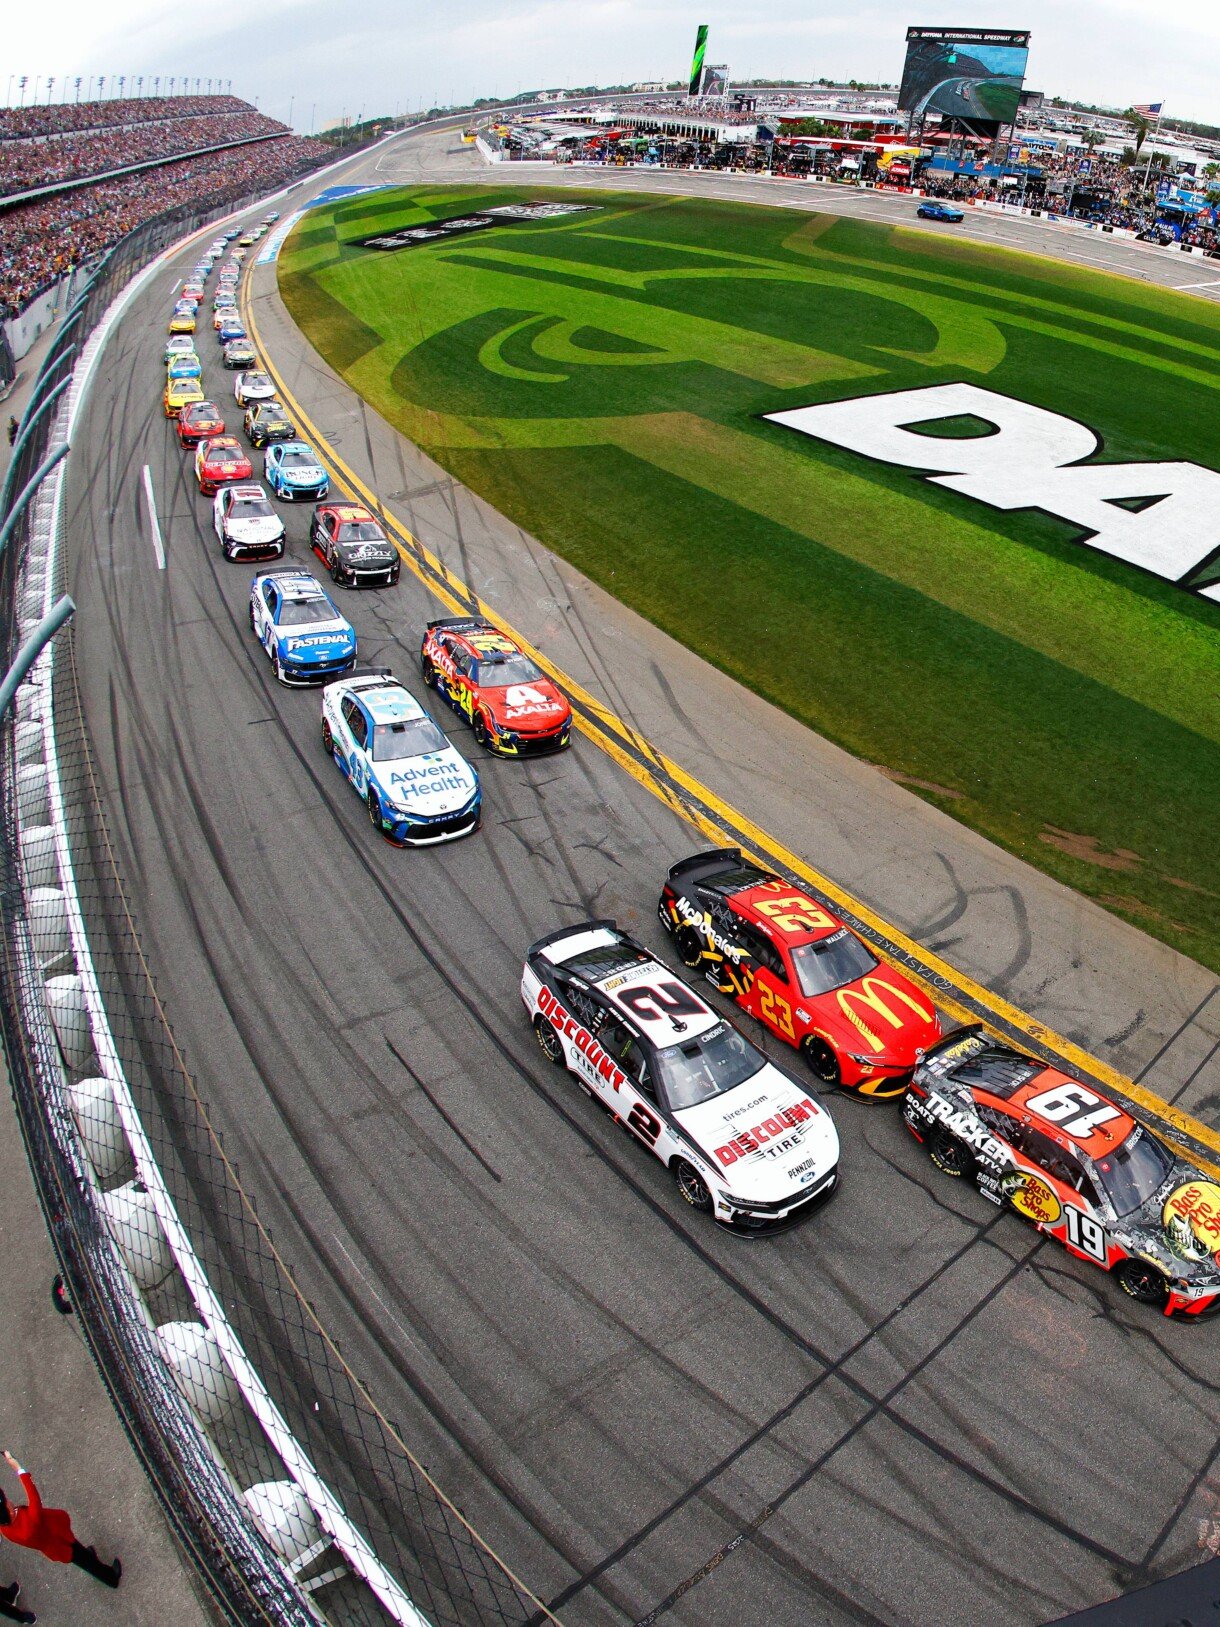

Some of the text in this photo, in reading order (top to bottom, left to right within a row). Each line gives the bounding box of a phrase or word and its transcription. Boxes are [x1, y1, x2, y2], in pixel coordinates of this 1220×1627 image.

[944, 32, 982, 40] INTERNATIONAL
[288, 634, 351, 651] FASTENAL
[426, 640, 457, 680] AXALTA
[506, 702, 563, 719] AXALTA
[390, 762, 460, 785] Advent
[400, 775, 469, 800] Health
[752, 896, 837, 932] 23
[825, 928, 850, 944] WALLACE
[617, 981, 707, 1022] 2
[757, 979, 796, 1040] 23
[537, 985, 628, 1095] DISCOUNT
[701, 1025, 725, 1043] CINDRIC
[574, 1049, 604, 1084] TIRE
[860, 1065, 874, 1074] 23
[722, 1094, 768, 1122] tires.com
[905, 1093, 936, 1125] BOATS
[1026, 1082, 1123, 1139] 19
[627, 1102, 662, 1147] 2
[714, 1099, 820, 1167] DISCOUNT
[925, 1091, 1012, 1166] TRACKER
[766, 1134, 801, 1158] TIRE
[1126, 1126, 1144, 1150] BRISCOE
[787, 1158, 816, 1180] PENNZOIL
[1025, 1187, 1043, 1205] Pro
[1026, 1178, 1052, 1201] Bass
[1170, 1186, 1202, 1217] Bass
[1020, 1196, 1051, 1221] Shops
[1188, 1202, 1214, 1227] Pro
[1063, 1205, 1106, 1261] 19
[1193, 1287, 1205, 1297] 19
